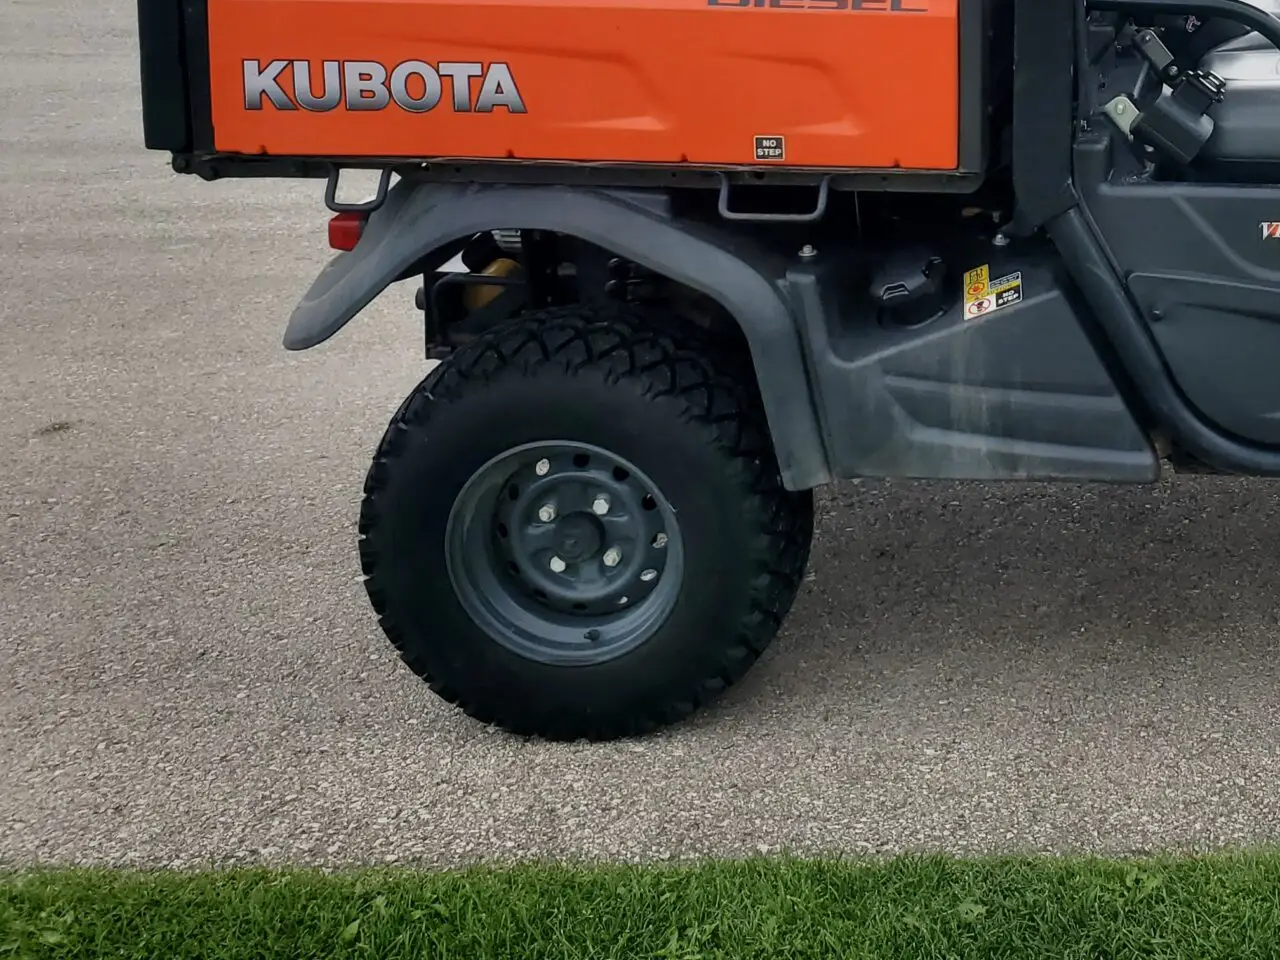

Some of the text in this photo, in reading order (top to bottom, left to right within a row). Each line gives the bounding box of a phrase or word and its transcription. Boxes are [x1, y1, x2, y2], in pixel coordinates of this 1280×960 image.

[242, 58, 528, 114] KUBOTA
[763, 139, 776, 147] NO
[757, 148, 782, 156] STEP
[998, 293, 1019, 305] STEP
